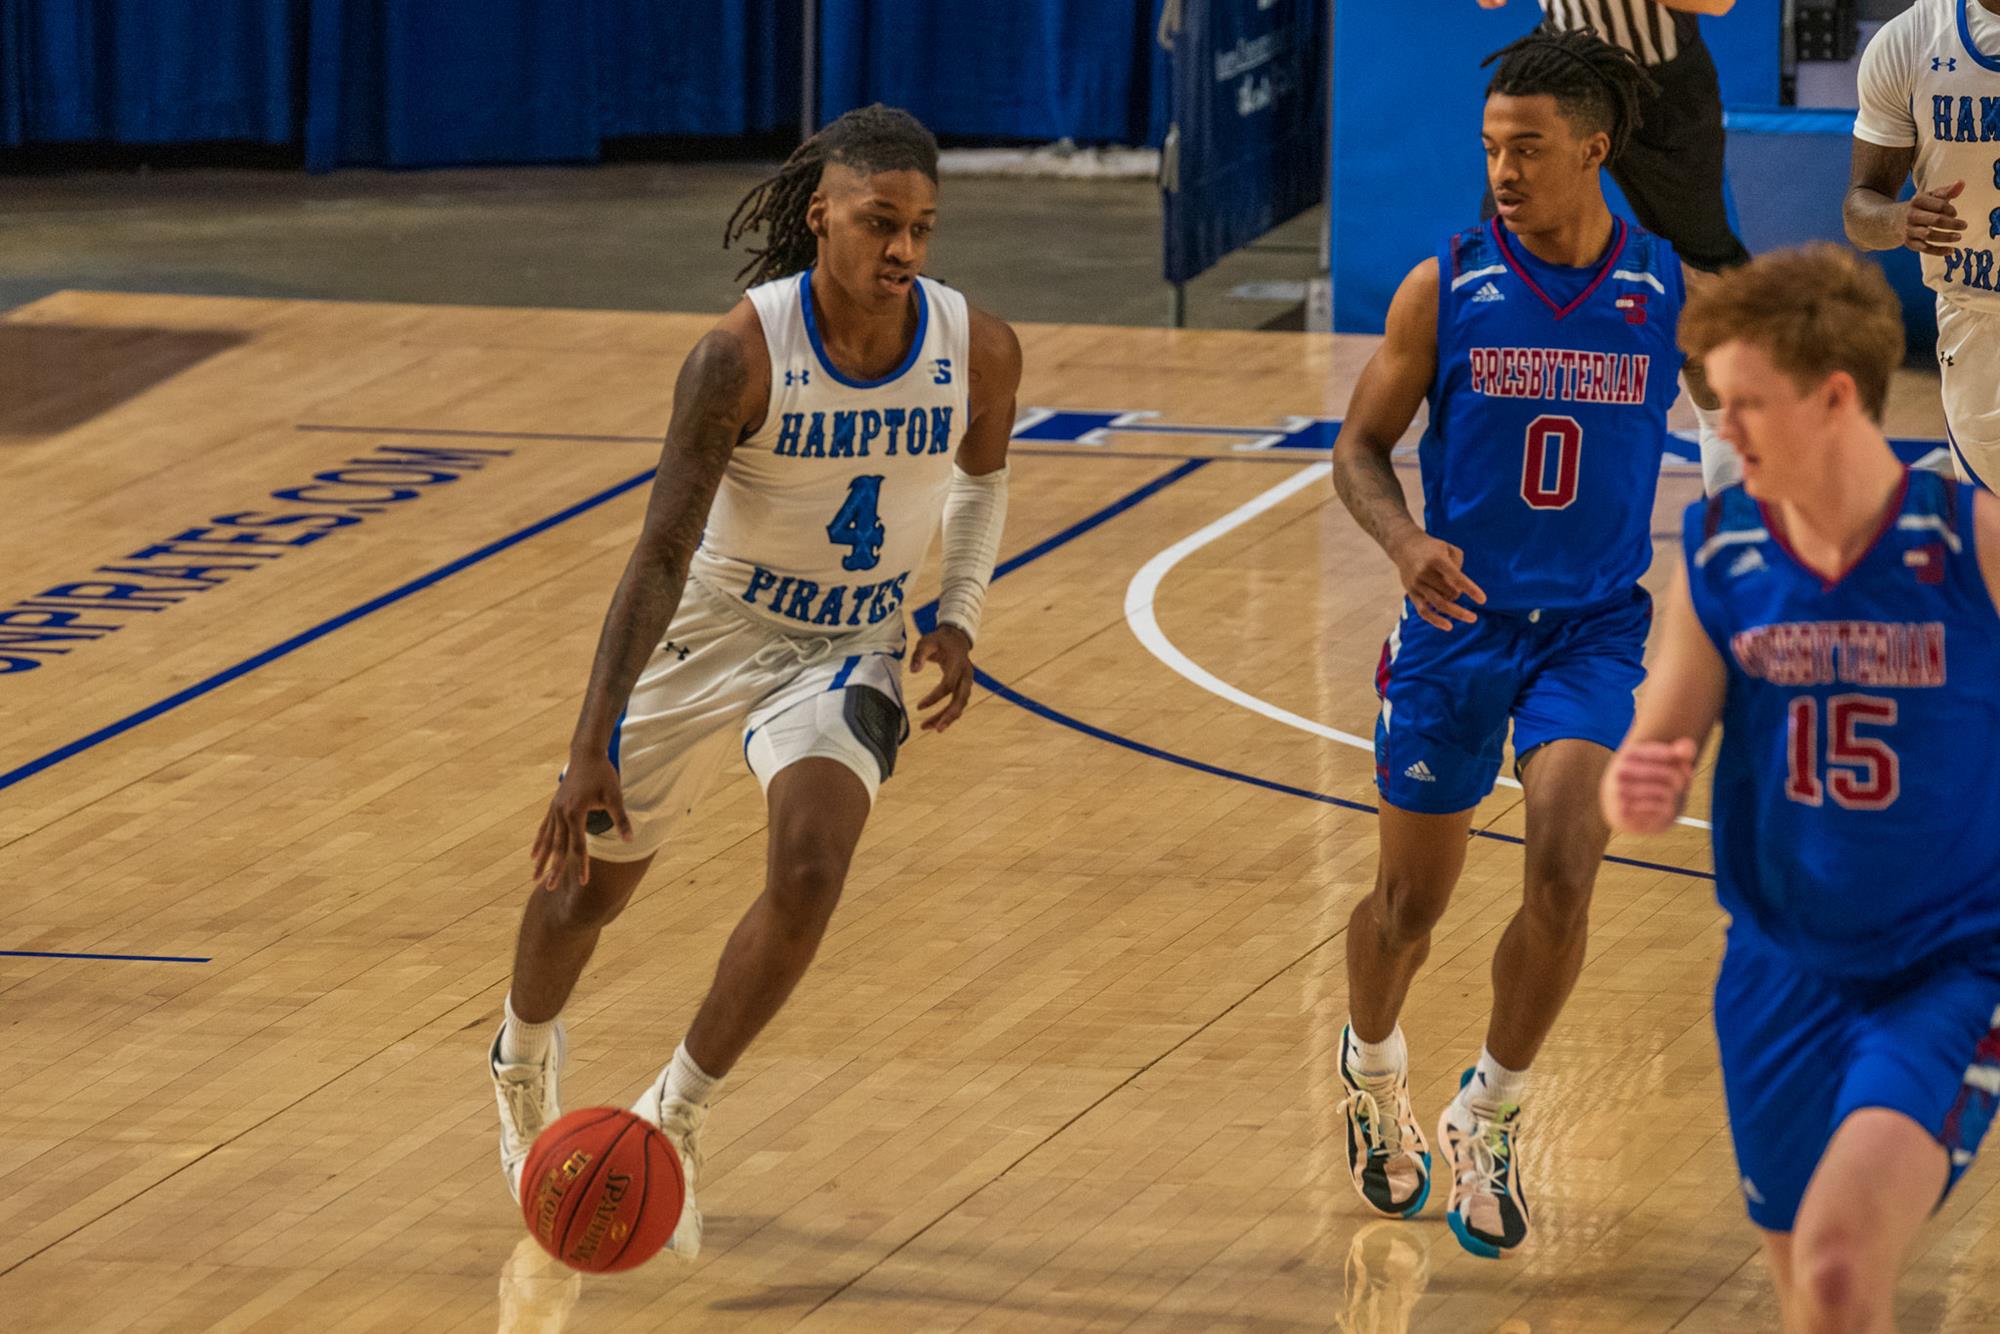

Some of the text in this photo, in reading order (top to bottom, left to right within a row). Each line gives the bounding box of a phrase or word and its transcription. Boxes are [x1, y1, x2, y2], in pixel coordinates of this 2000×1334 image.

[1944, 246, 2000, 292] PIR
[1470, 347, 1650, 405] PRESBYTERIAN
[773, 406, 953, 458] HAMPTON
[1519, 414, 1583, 510] 0
[0, 445, 515, 674] NPIRATES.COM
[825, 475, 886, 571] 4
[741, 566, 911, 626] PIRATES
[1784, 693, 1900, 810] 15
